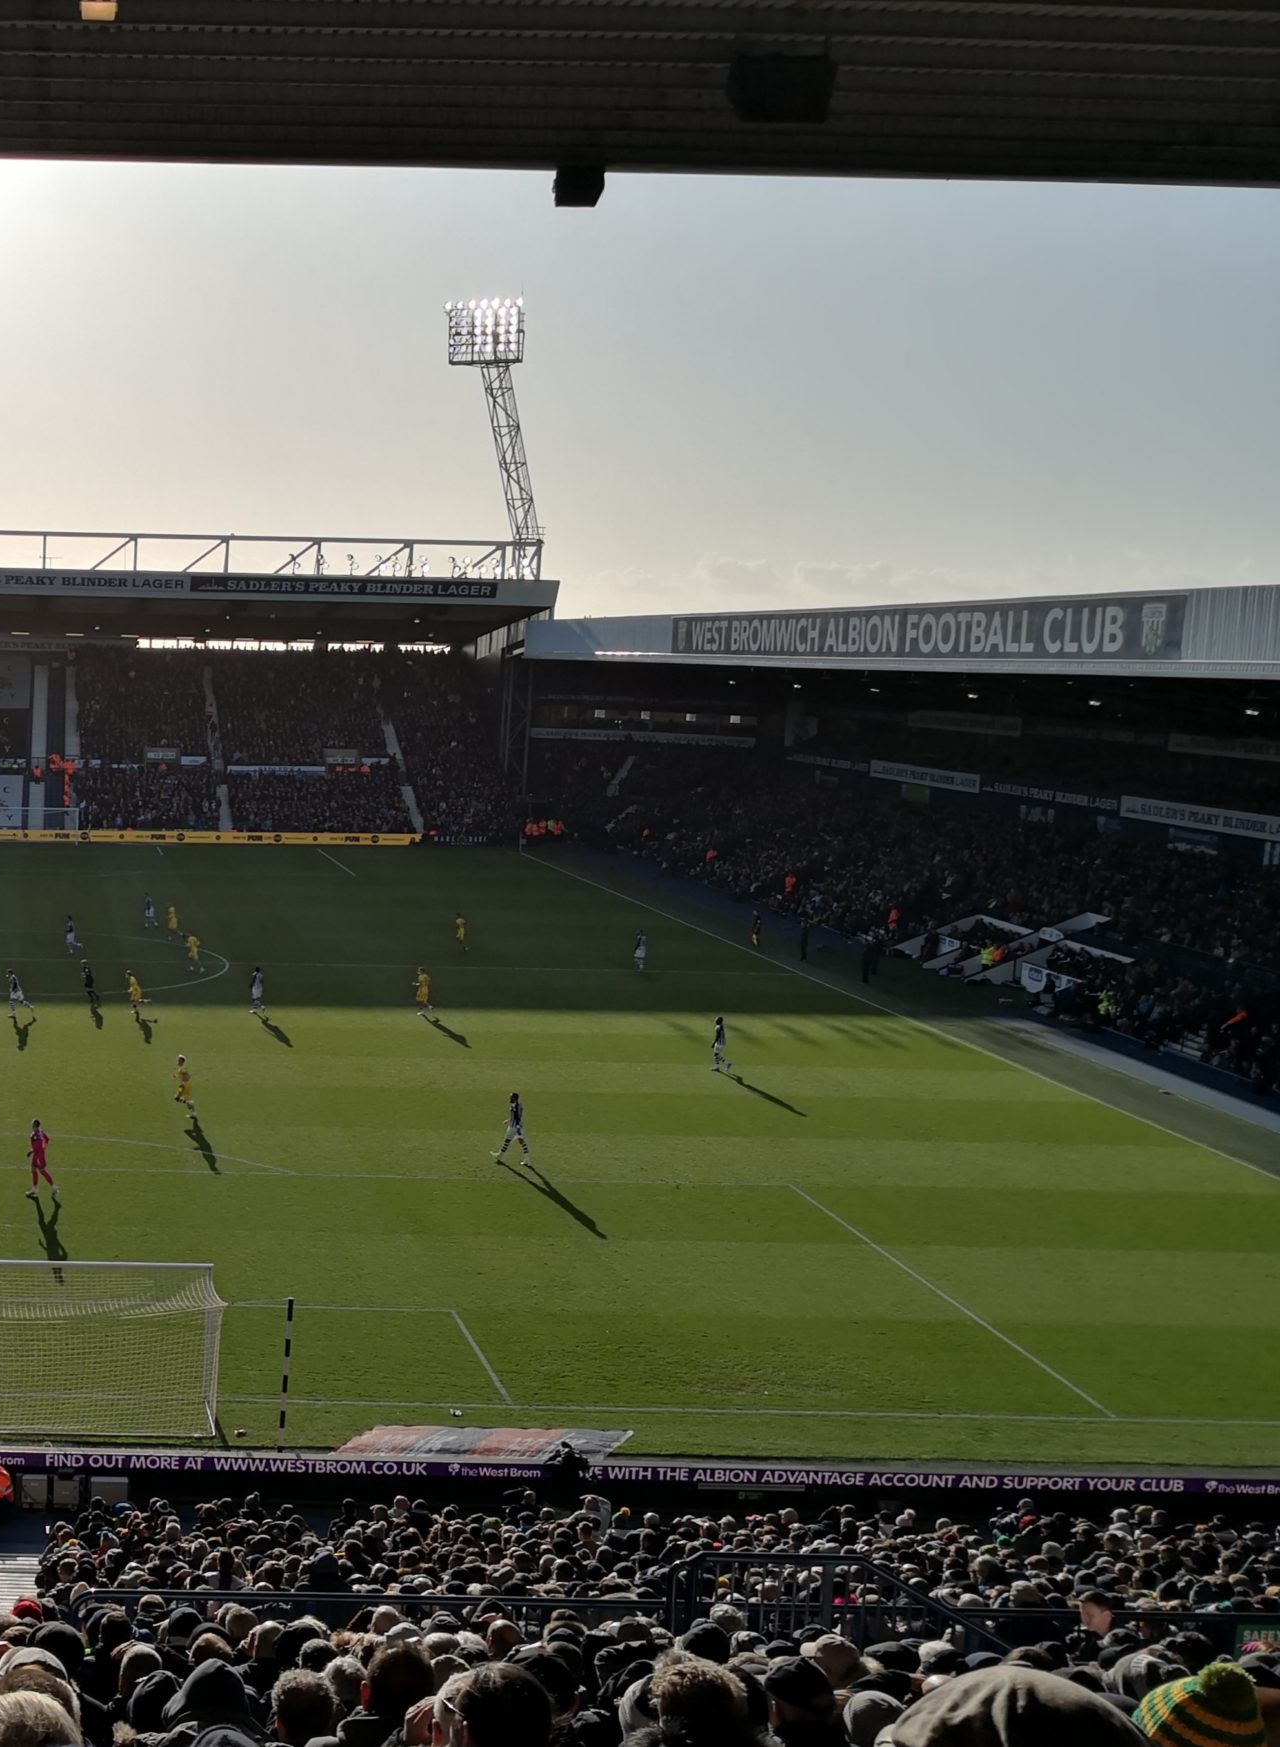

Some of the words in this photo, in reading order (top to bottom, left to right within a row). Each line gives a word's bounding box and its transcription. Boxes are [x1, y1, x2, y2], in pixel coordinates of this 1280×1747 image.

[5, 575, 57, 586] PEAKY
[61, 576, 128, 588] BLINDER
[132, 578, 184, 589] LAGER
[227, 580, 304, 592] SADLER'S
[308, 582, 362, 593] PEAKY
[365, 583, 434, 595] BLINDER
[437, 585, 491, 596] LAGER
[691, 620, 728, 652] WEST
[731, 618, 819, 652] BROMWICH
[824, 615, 901, 653] ALBION
[905, 609, 1034, 653] FOOTBALL
[1042, 606, 1123, 654] CLUB
[1089, 797, 1118, 811] LAGER
[1140, 803, 1185, 821] SADLER'S
[1188, 810, 1220, 826] PEAKY
[1223, 815, 1266, 833] BLINDER
[45, 1454, 84, 1468] FIND
[89, 1455, 125, 1469] OUT
[130, 1456, 180, 1470] MORE
[184, 1457, 205, 1470] AT
[214, 1458, 427, 1476] WWW.WESTBROM.CO.UK
[460, 1466, 478, 1477] the
[478, 1467, 508, 1478] West
[510, 1467, 541, 1478] Brom
[608, 1466, 651, 1481] WITH
[657, 1468, 688, 1482] THE
[693, 1469, 757, 1483] ALBION
[761, 1470, 864, 1486] ADVANTAGE
[869, 1473, 955, 1488] ACCOUNT
[959, 1475, 998, 1489] AND
[1002, 1475, 1085, 1491] SUPPORT
[1087, 1477, 1136, 1492] YOUR
[1140, 1478, 1184, 1493] CLUB
[1236, 1483, 1266, 1494] West
